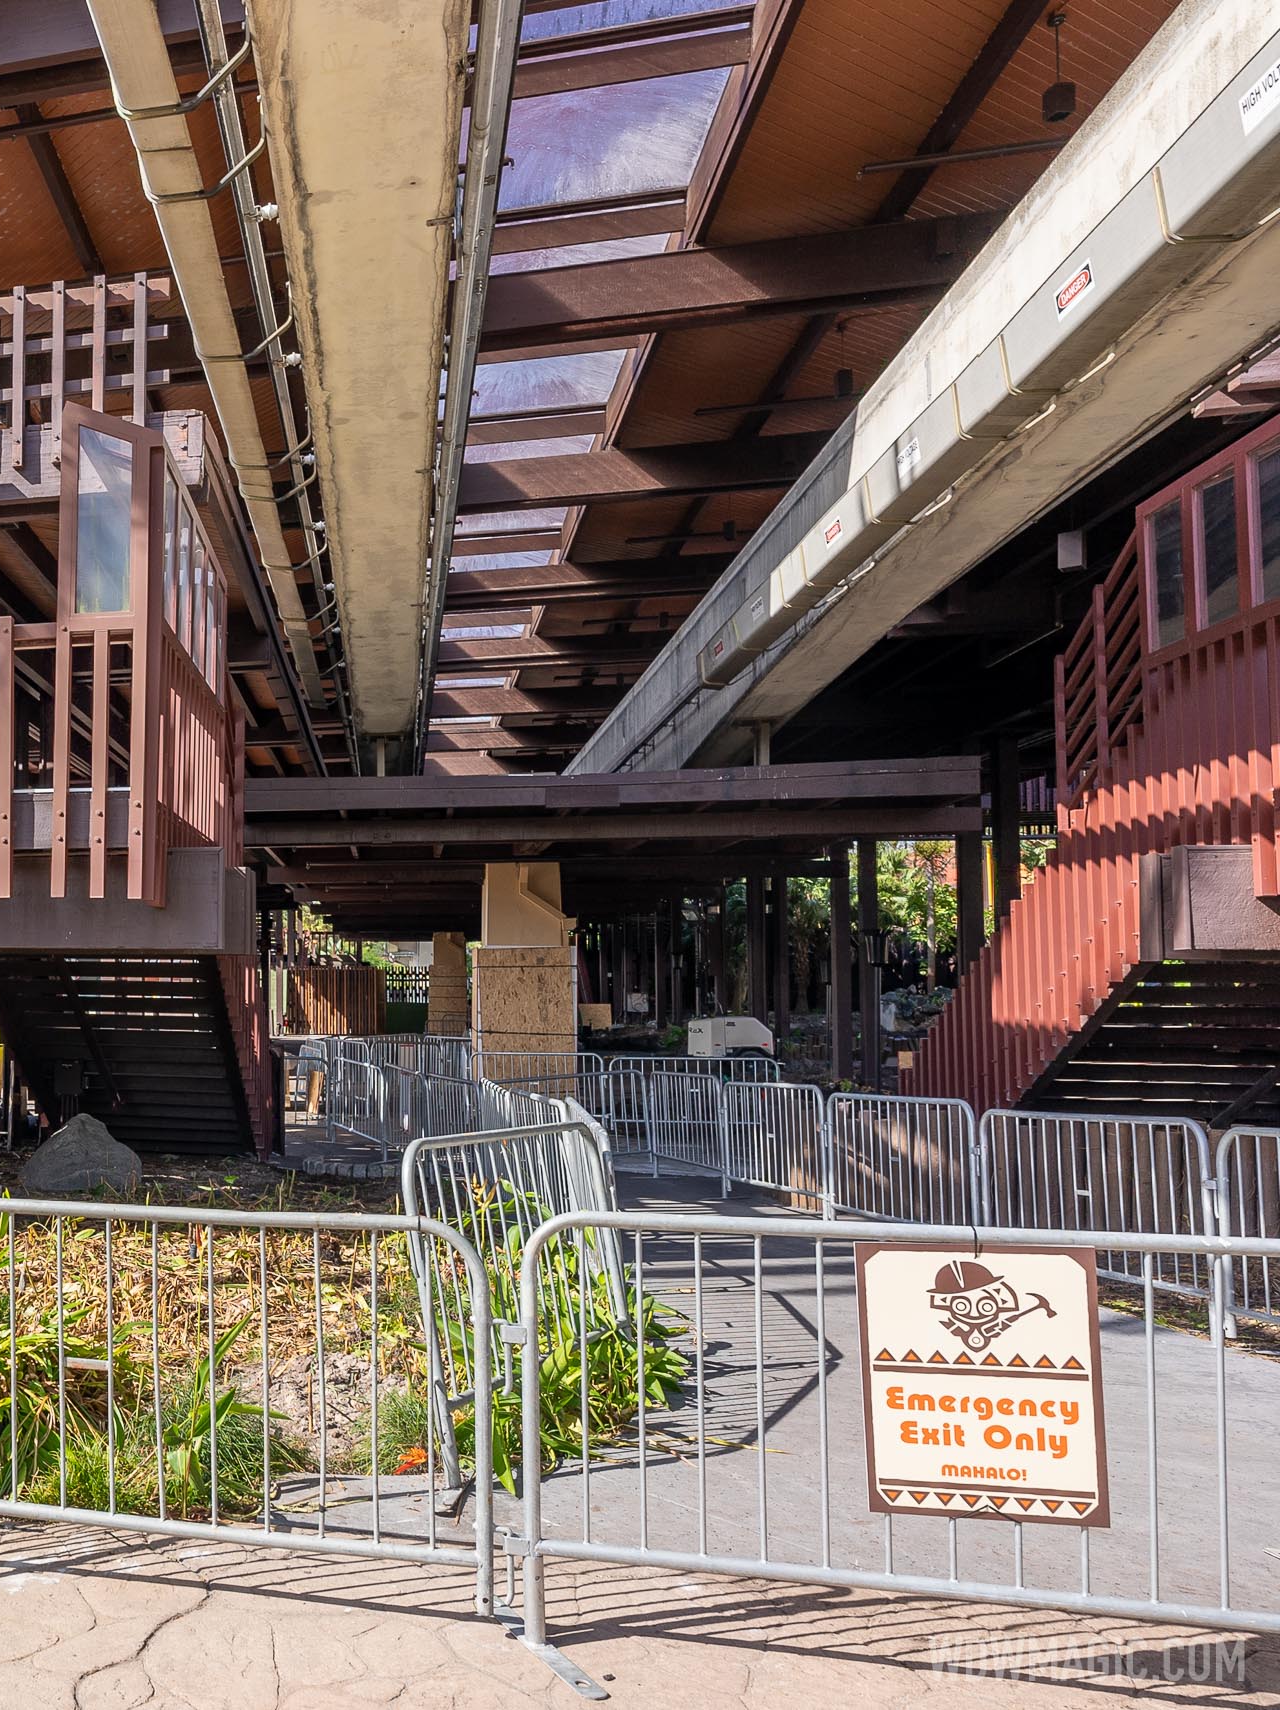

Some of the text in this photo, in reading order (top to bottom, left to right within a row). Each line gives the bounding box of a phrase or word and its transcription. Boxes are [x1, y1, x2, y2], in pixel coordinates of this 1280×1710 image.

[1242, 86, 1261, 115] HIGH
[1061, 273, 1088, 305] DANGER
[886, 1386, 1080, 1425] Emergency
[900, 1420, 1069, 1460] Exit Only
[941, 1464, 1027, 1482] MAHALO!
